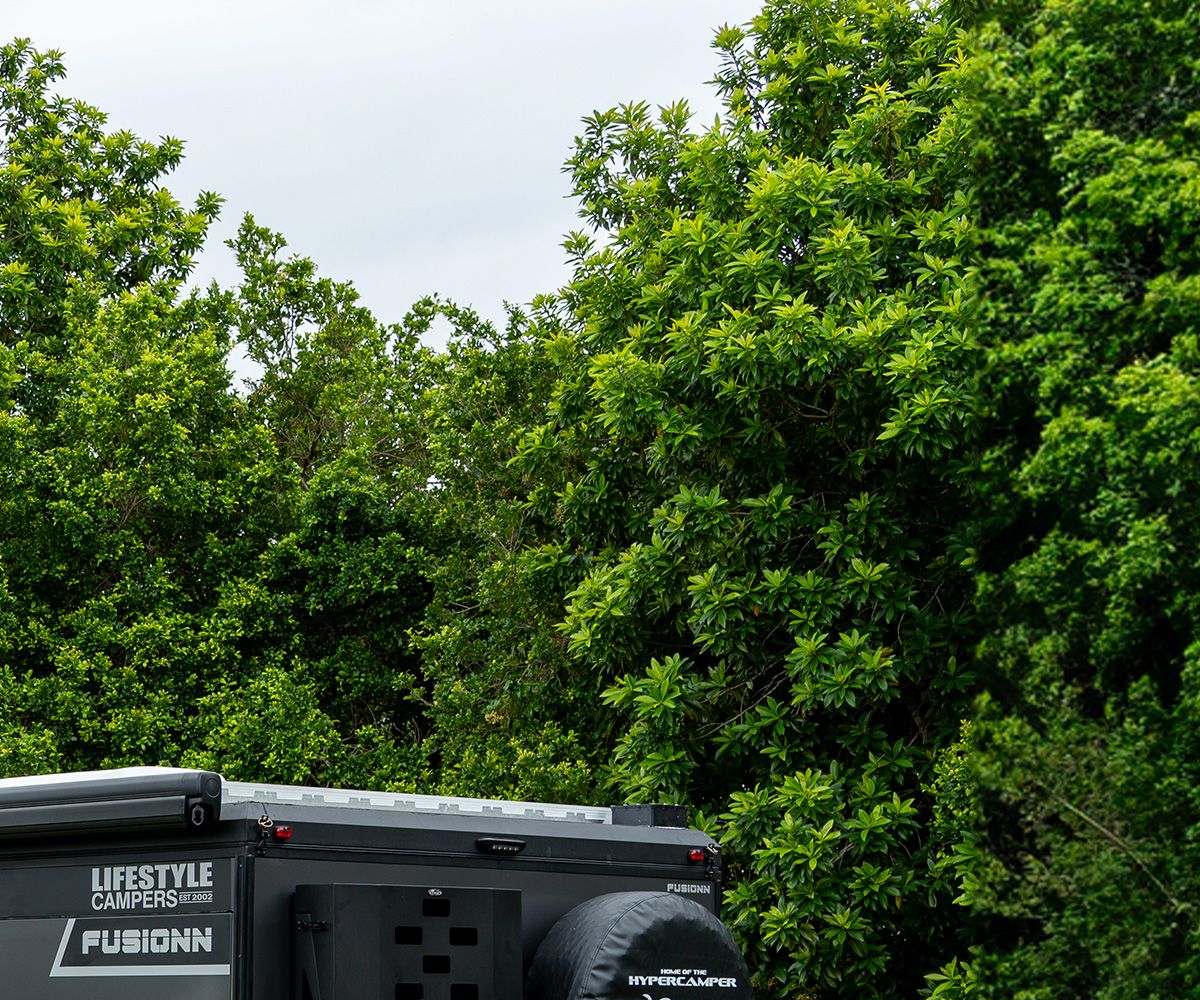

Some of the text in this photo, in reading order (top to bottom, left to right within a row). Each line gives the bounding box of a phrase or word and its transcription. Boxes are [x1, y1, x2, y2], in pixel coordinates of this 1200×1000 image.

[91, 862, 213, 892] LIFESTYLE
[666, 883, 711, 894] FUSIONN
[91, 889, 178, 911] CAMPERS
[192, 893, 213, 901] 2002
[82, 927, 212, 954] FUSIONN
[628, 975, 737, 988] HYPERCAMPER
